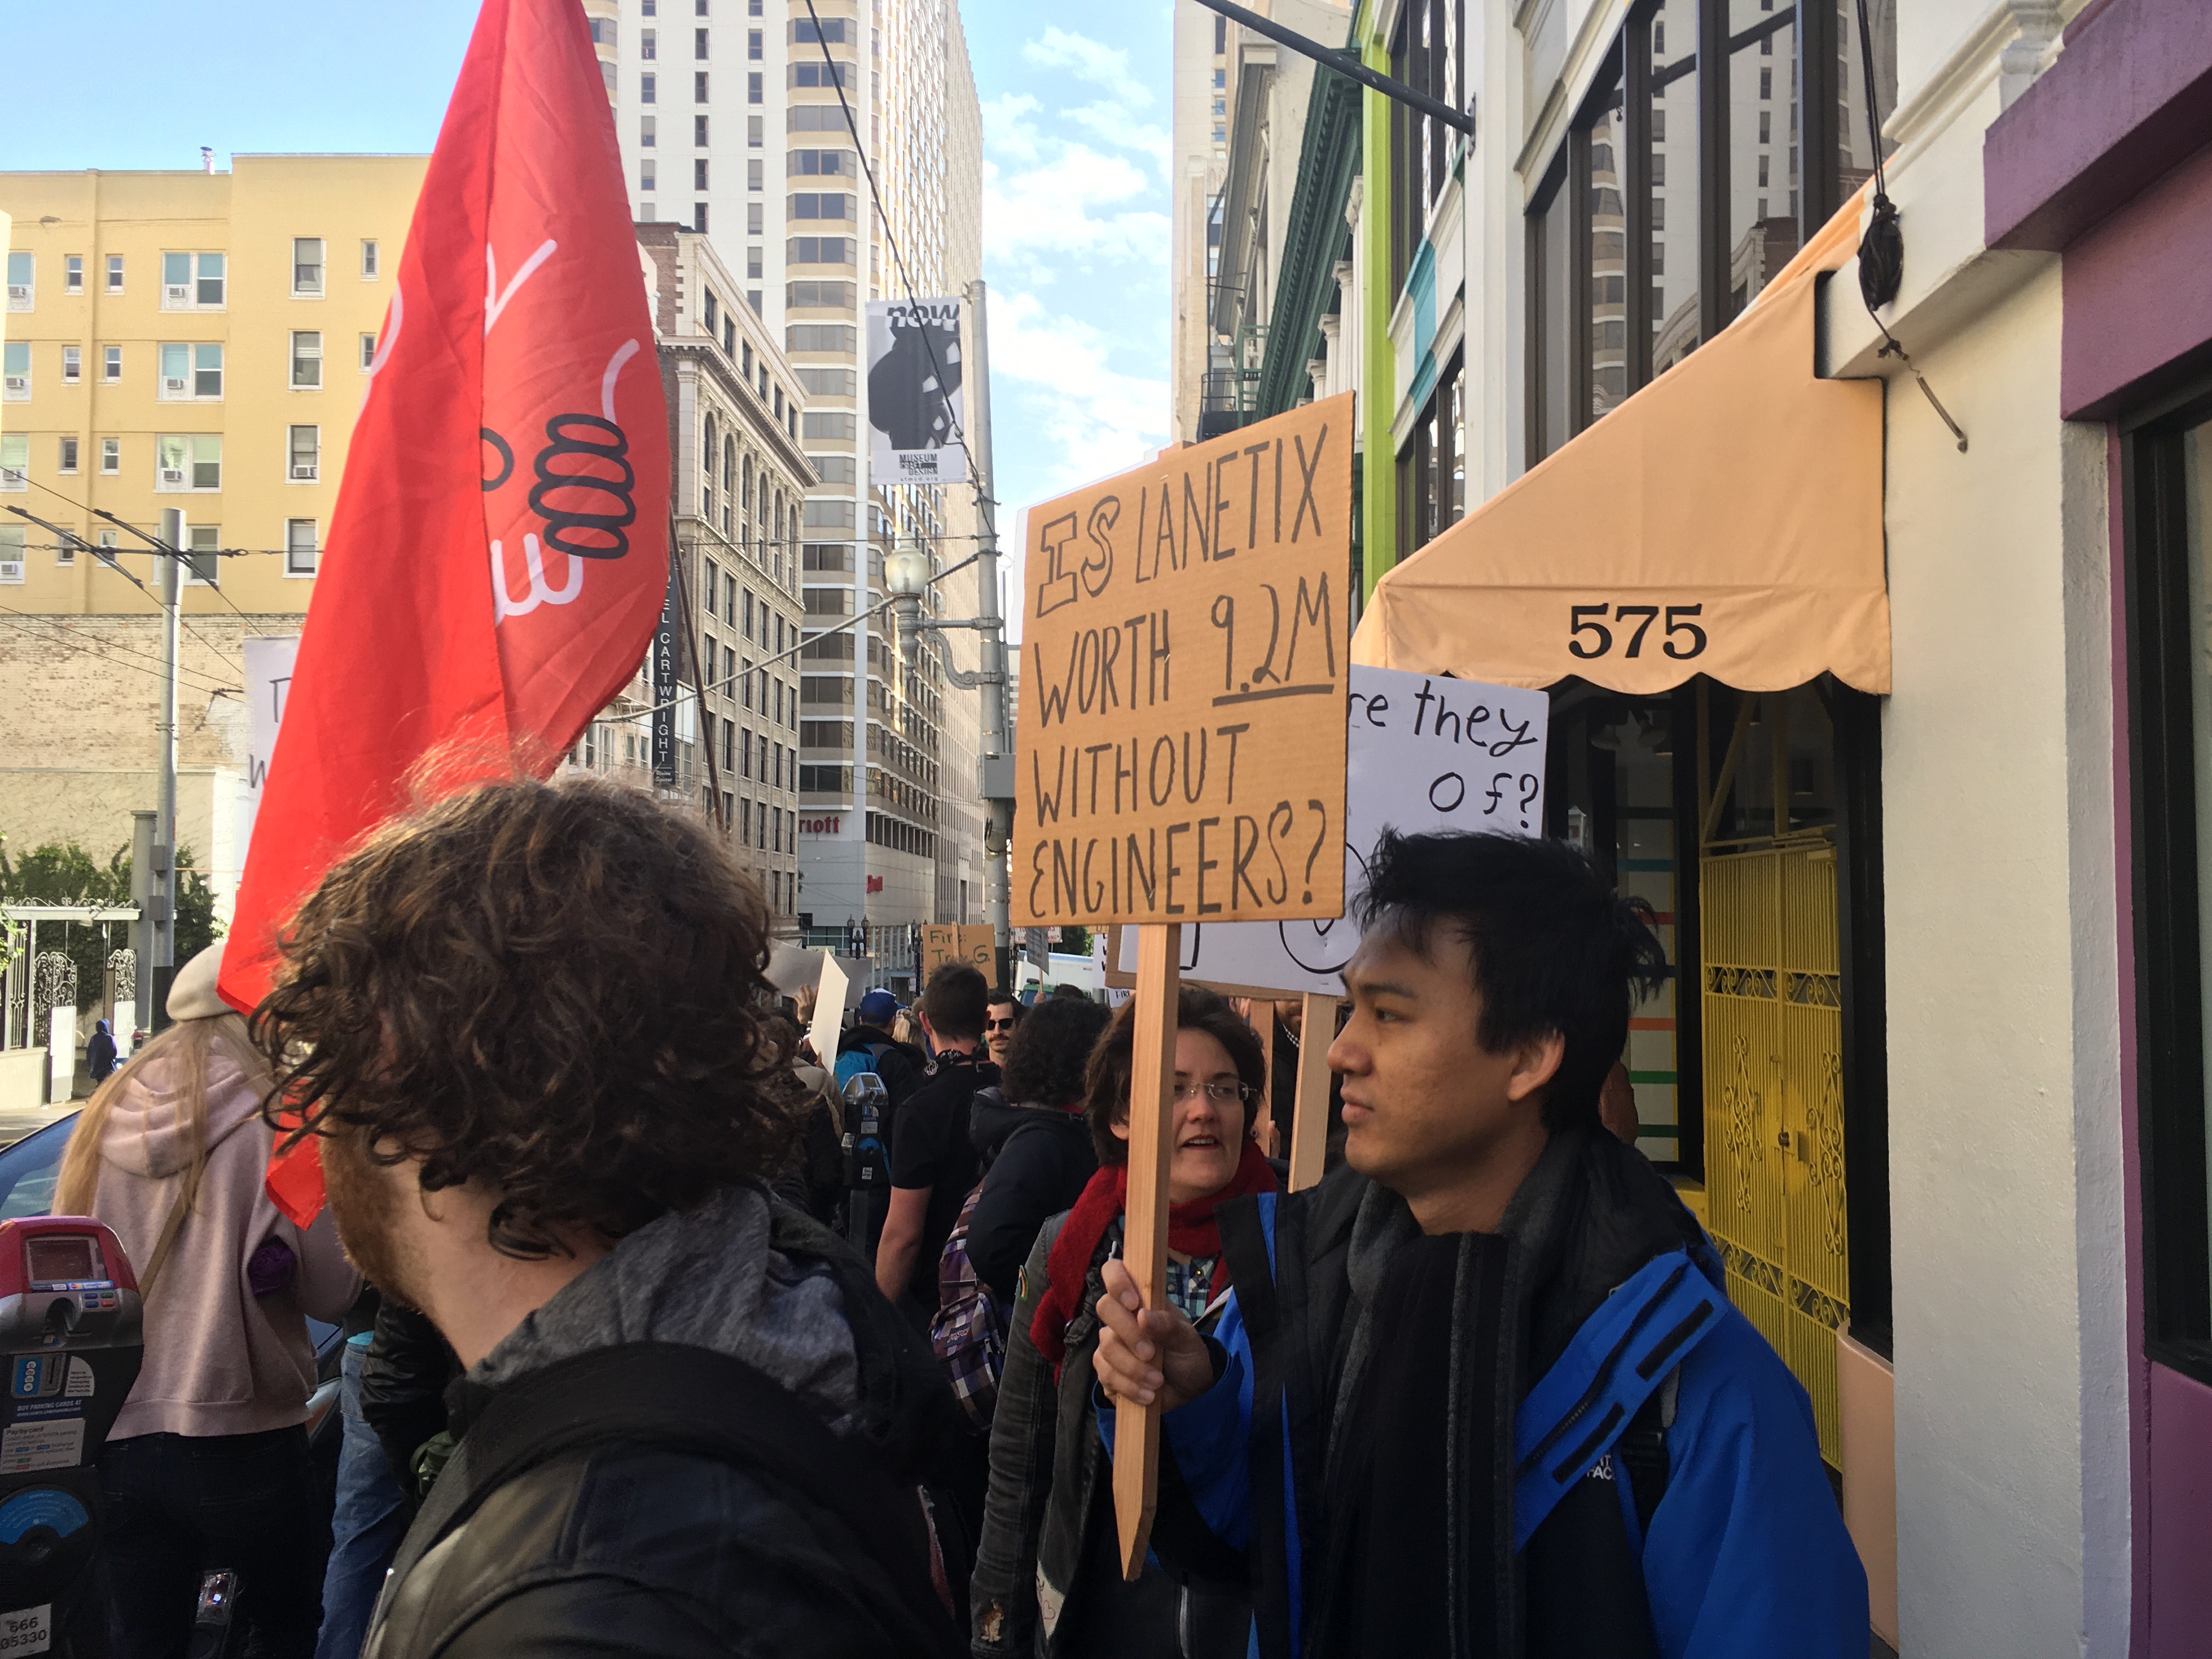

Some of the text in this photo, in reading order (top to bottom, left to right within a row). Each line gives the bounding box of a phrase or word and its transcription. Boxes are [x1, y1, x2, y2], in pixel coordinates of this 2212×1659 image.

[885, 304, 960, 327] now
[899, 453, 937, 462] MUSEUM
[1036, 423, 1328, 618] IS LANETIX
[1034, 608, 1170, 729] WORTH
[1568, 602, 1707, 659] 575
[658, 633, 673, 762] CARTWRIGHT
[1414, 680, 1538, 757] they
[1034, 723, 1250, 828] WITHOUT
[799, 816, 840, 833] riott
[1029, 799, 1326, 919] ENGINEERS?
